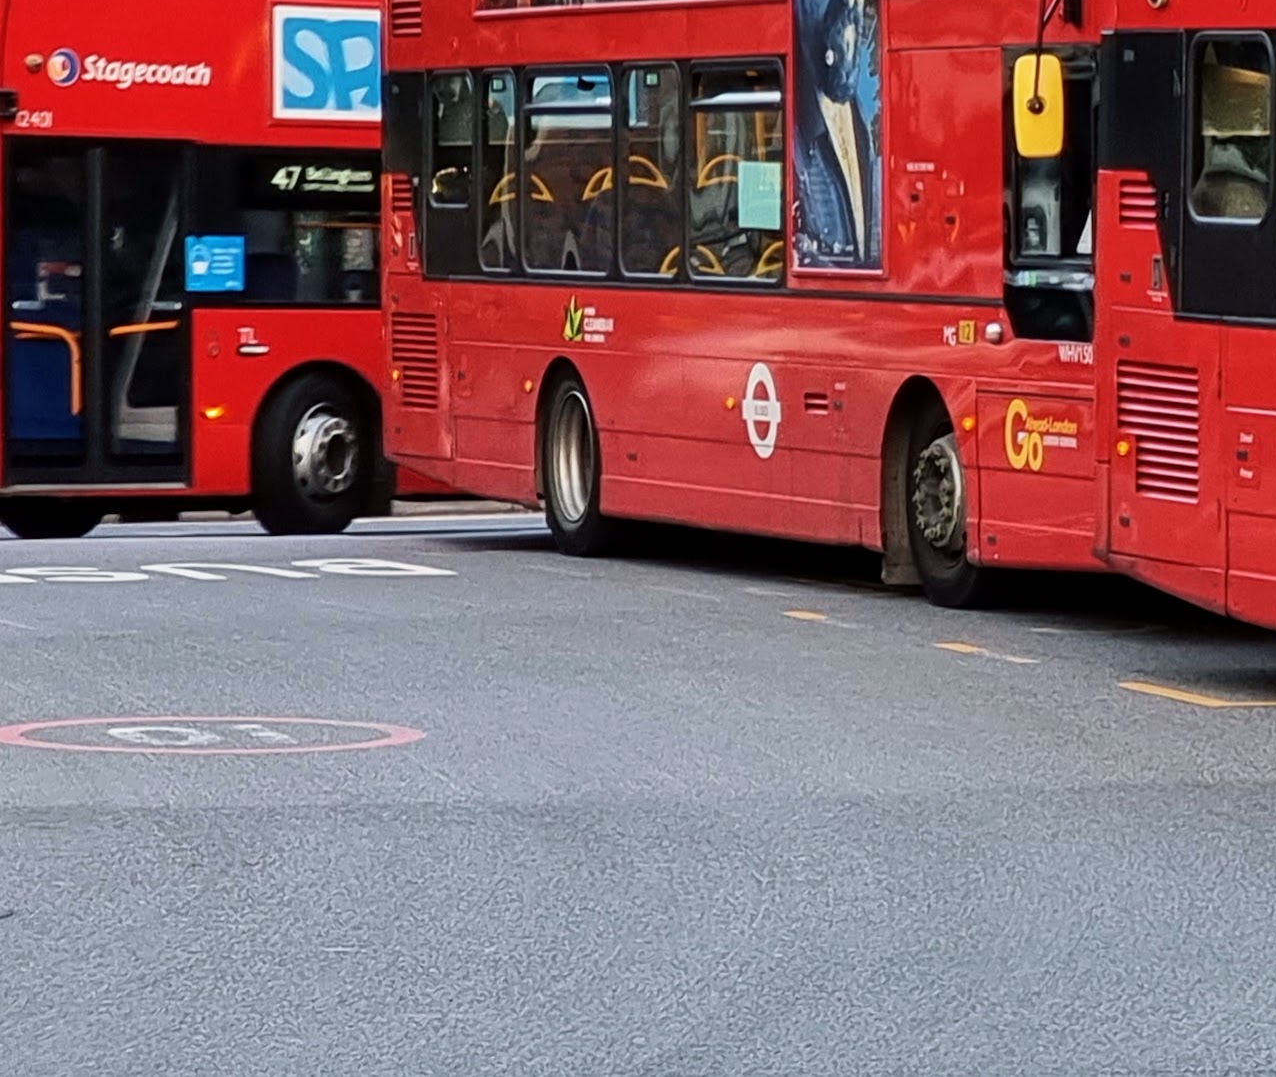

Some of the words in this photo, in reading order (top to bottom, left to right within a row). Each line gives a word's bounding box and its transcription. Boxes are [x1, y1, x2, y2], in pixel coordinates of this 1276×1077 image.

[82, 54, 212, 90] Stagecoach
[270, 166, 302, 190] 47
[1004, 398, 1043, 472] Go
